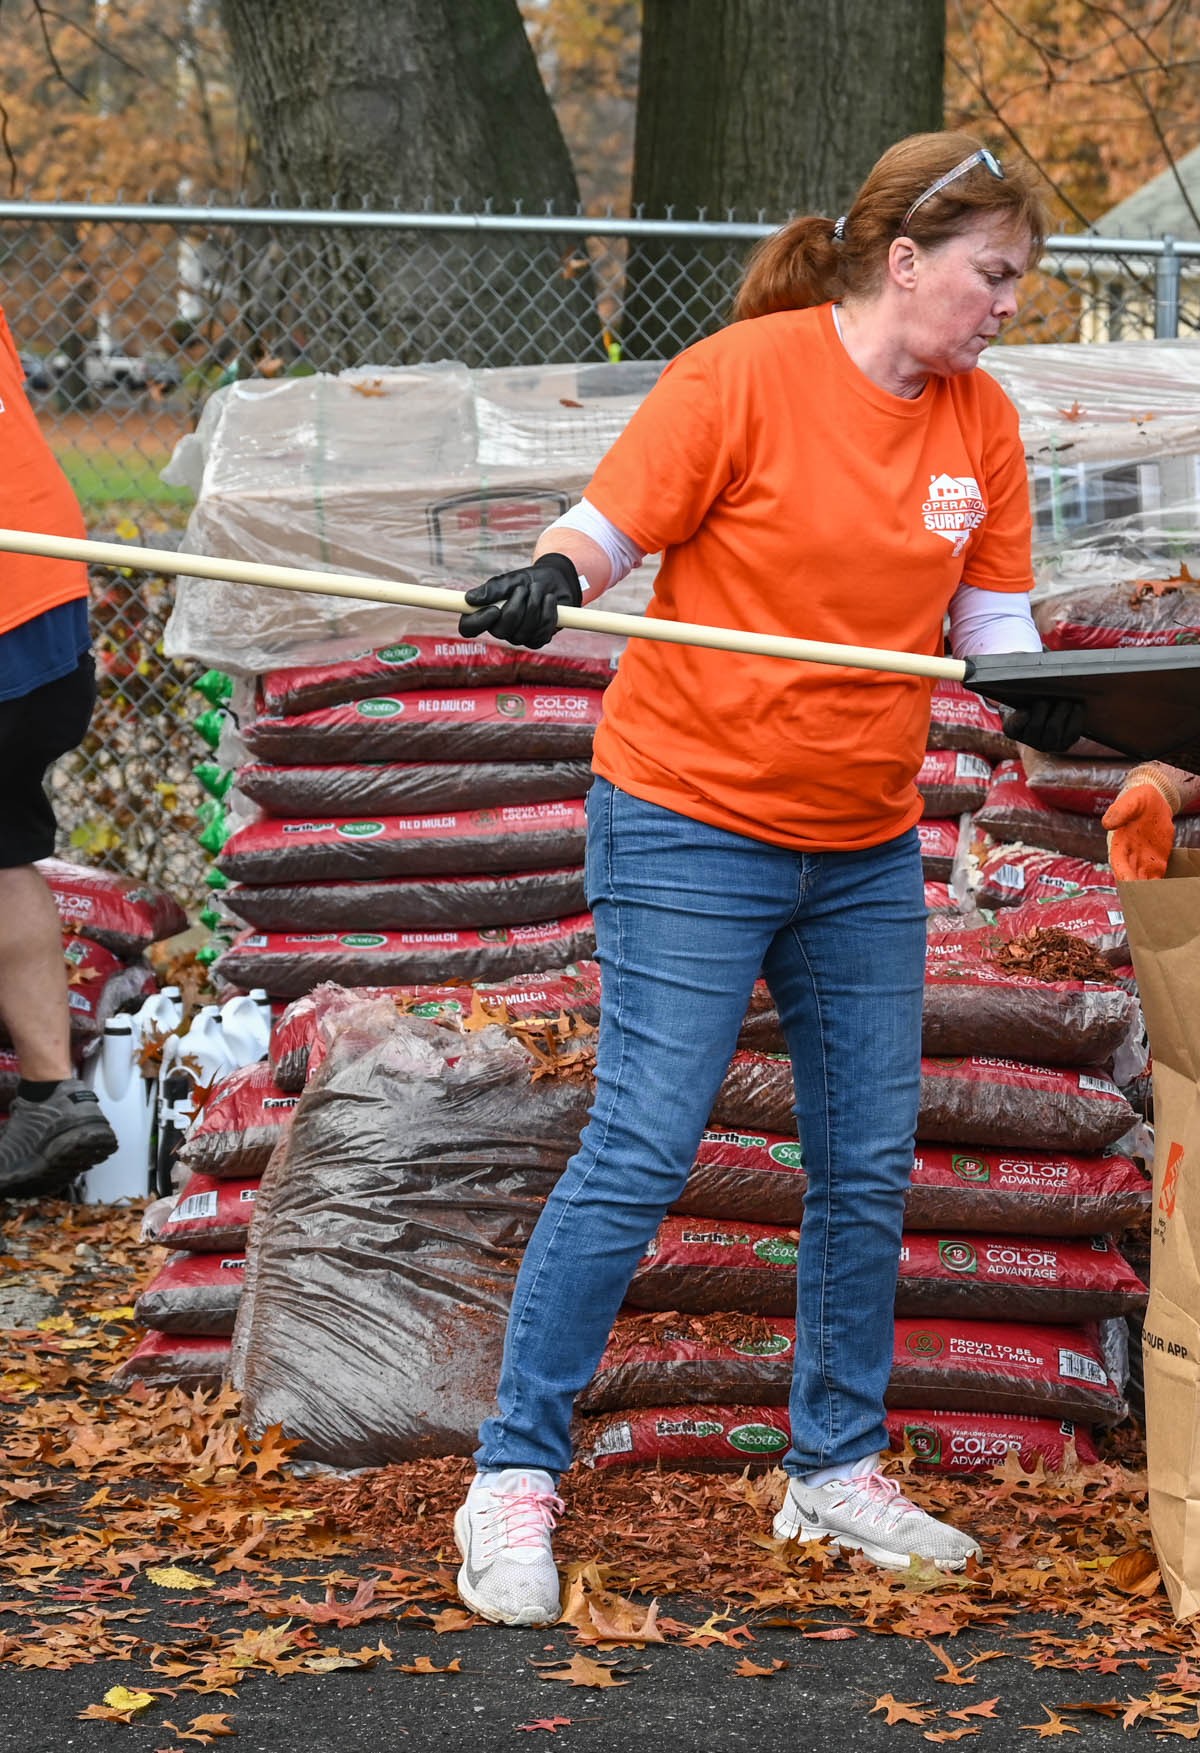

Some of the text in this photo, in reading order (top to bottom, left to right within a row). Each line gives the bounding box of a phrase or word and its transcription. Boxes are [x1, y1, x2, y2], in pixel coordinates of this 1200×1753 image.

[921, 499, 987, 512] OPERATION
[923, 512, 985, 530] SURPISE
[435, 643, 487, 656] RED MULCH
[361, 701, 397, 713] Scotts
[418, 700, 476, 712] RED MULCH
[532, 698, 589, 710] COLOR
[931, 700, 981, 713] COLOR
[533, 709, 588, 719] ADVANTAGE
[502, 808, 574, 821] LOCALLY MADE
[343, 822, 378, 834] Scotts
[399, 817, 456, 830] RED MULCH
[345, 934, 380, 944] Scotts
[401, 932, 458, 943] RED MULCH
[506, 991, 547, 1005] MULCH
[971, 1058, 1026, 1072] LOCALLY
[1031, 1067, 1064, 1077] MADE
[263, 1098, 300, 1109] Earth
[701, 1130, 767, 1147] Earthgro
[778, 1146, 801, 1160] Sco
[966, 1161, 976, 1169] 12
[999, 1162, 1069, 1178] COLOR
[1000, 1175, 1069, 1188] ADVANTAGE
[682, 1231, 750, 1246] Earth
[952, 1248, 963, 1258] 12
[986, 1248, 1057, 1267] COLOR
[987, 1264, 1057, 1279] ADVANTAGE
[950, 1338, 1031, 1356] PROUD TO BE
[1146, 1333, 1165, 1352] OUR
[1167, 1341, 1188, 1359] APP
[950, 1344, 1005, 1360] LOCALLY
[1009, 1353, 1044, 1365] MADE
[738, 1432, 781, 1446] Scotts
[917, 1438, 928, 1447] 12
[951, 1437, 1022, 1456] COLOR
[950, 1455, 1006, 1467] ADVANTA
